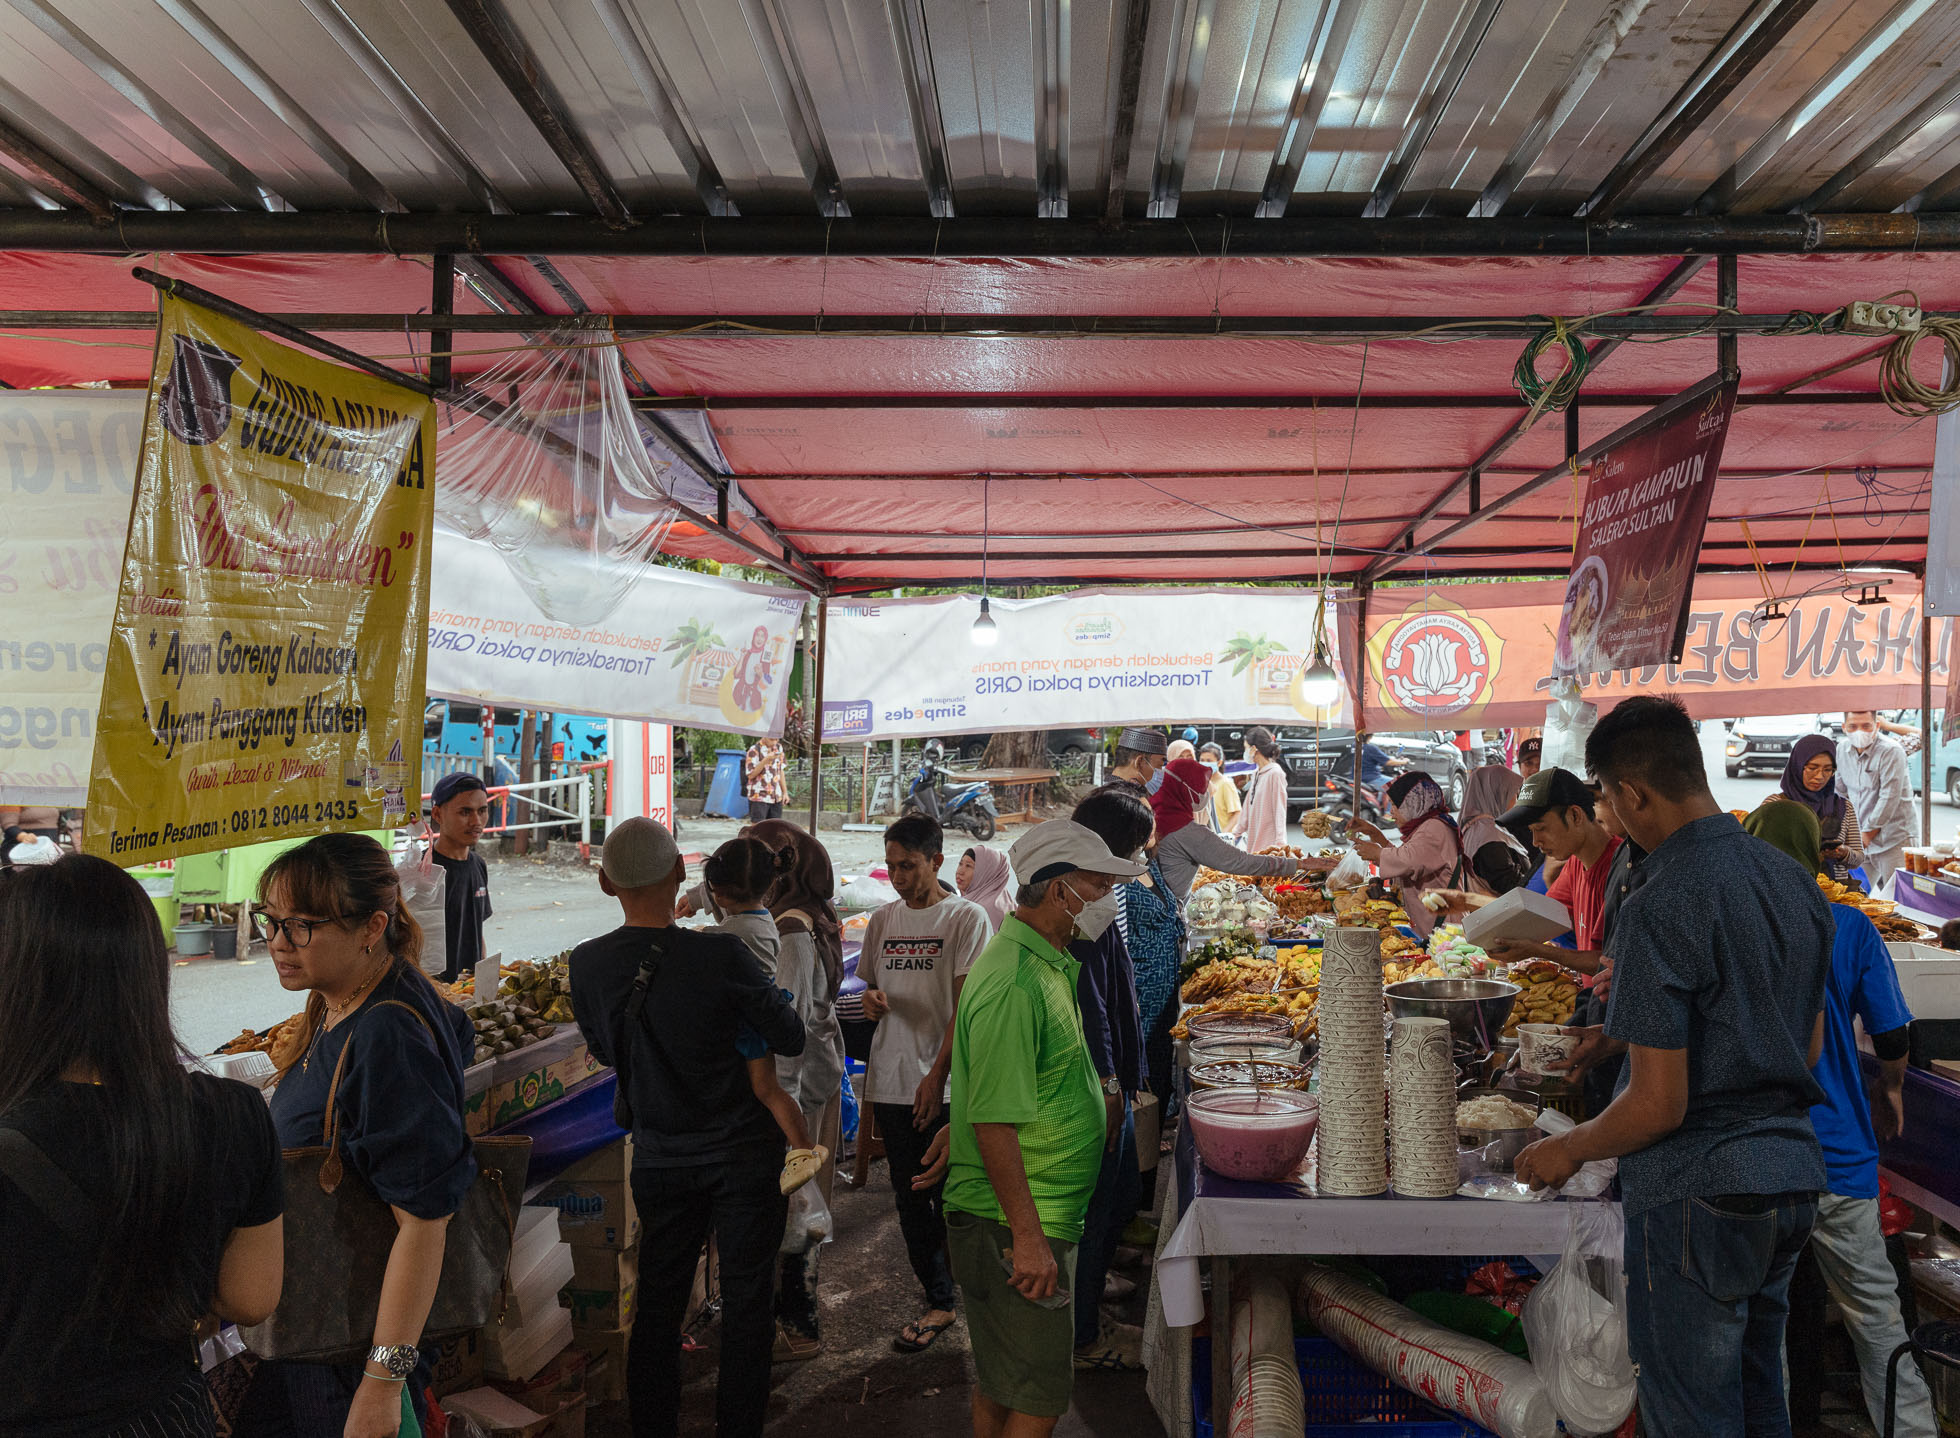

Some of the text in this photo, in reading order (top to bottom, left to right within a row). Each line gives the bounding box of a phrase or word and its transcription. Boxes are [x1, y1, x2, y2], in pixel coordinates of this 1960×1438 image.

[240, 368, 331, 465] GUDEG
[1583, 451, 1707, 529] BUBUR KAMPIUN
[1589, 499, 1676, 549] SALERO SULTAN
[162, 629, 358, 690] Ayam Goreng Kalasan
[153, 692, 367, 760] Ayam Panggang Klaten
[223, 762, 260, 786] Lezat
[263, 762, 275, 781] &
[278, 758, 328, 782] Nikmat
[110, 827, 157, 854] Terima
[163, 819, 218, 845] Pesanan
[231, 808, 268, 832] 0812
[272, 804, 309, 826] 8044
[315, 800, 358, 822] 2435
[885, 959, 934, 971] JEANS
